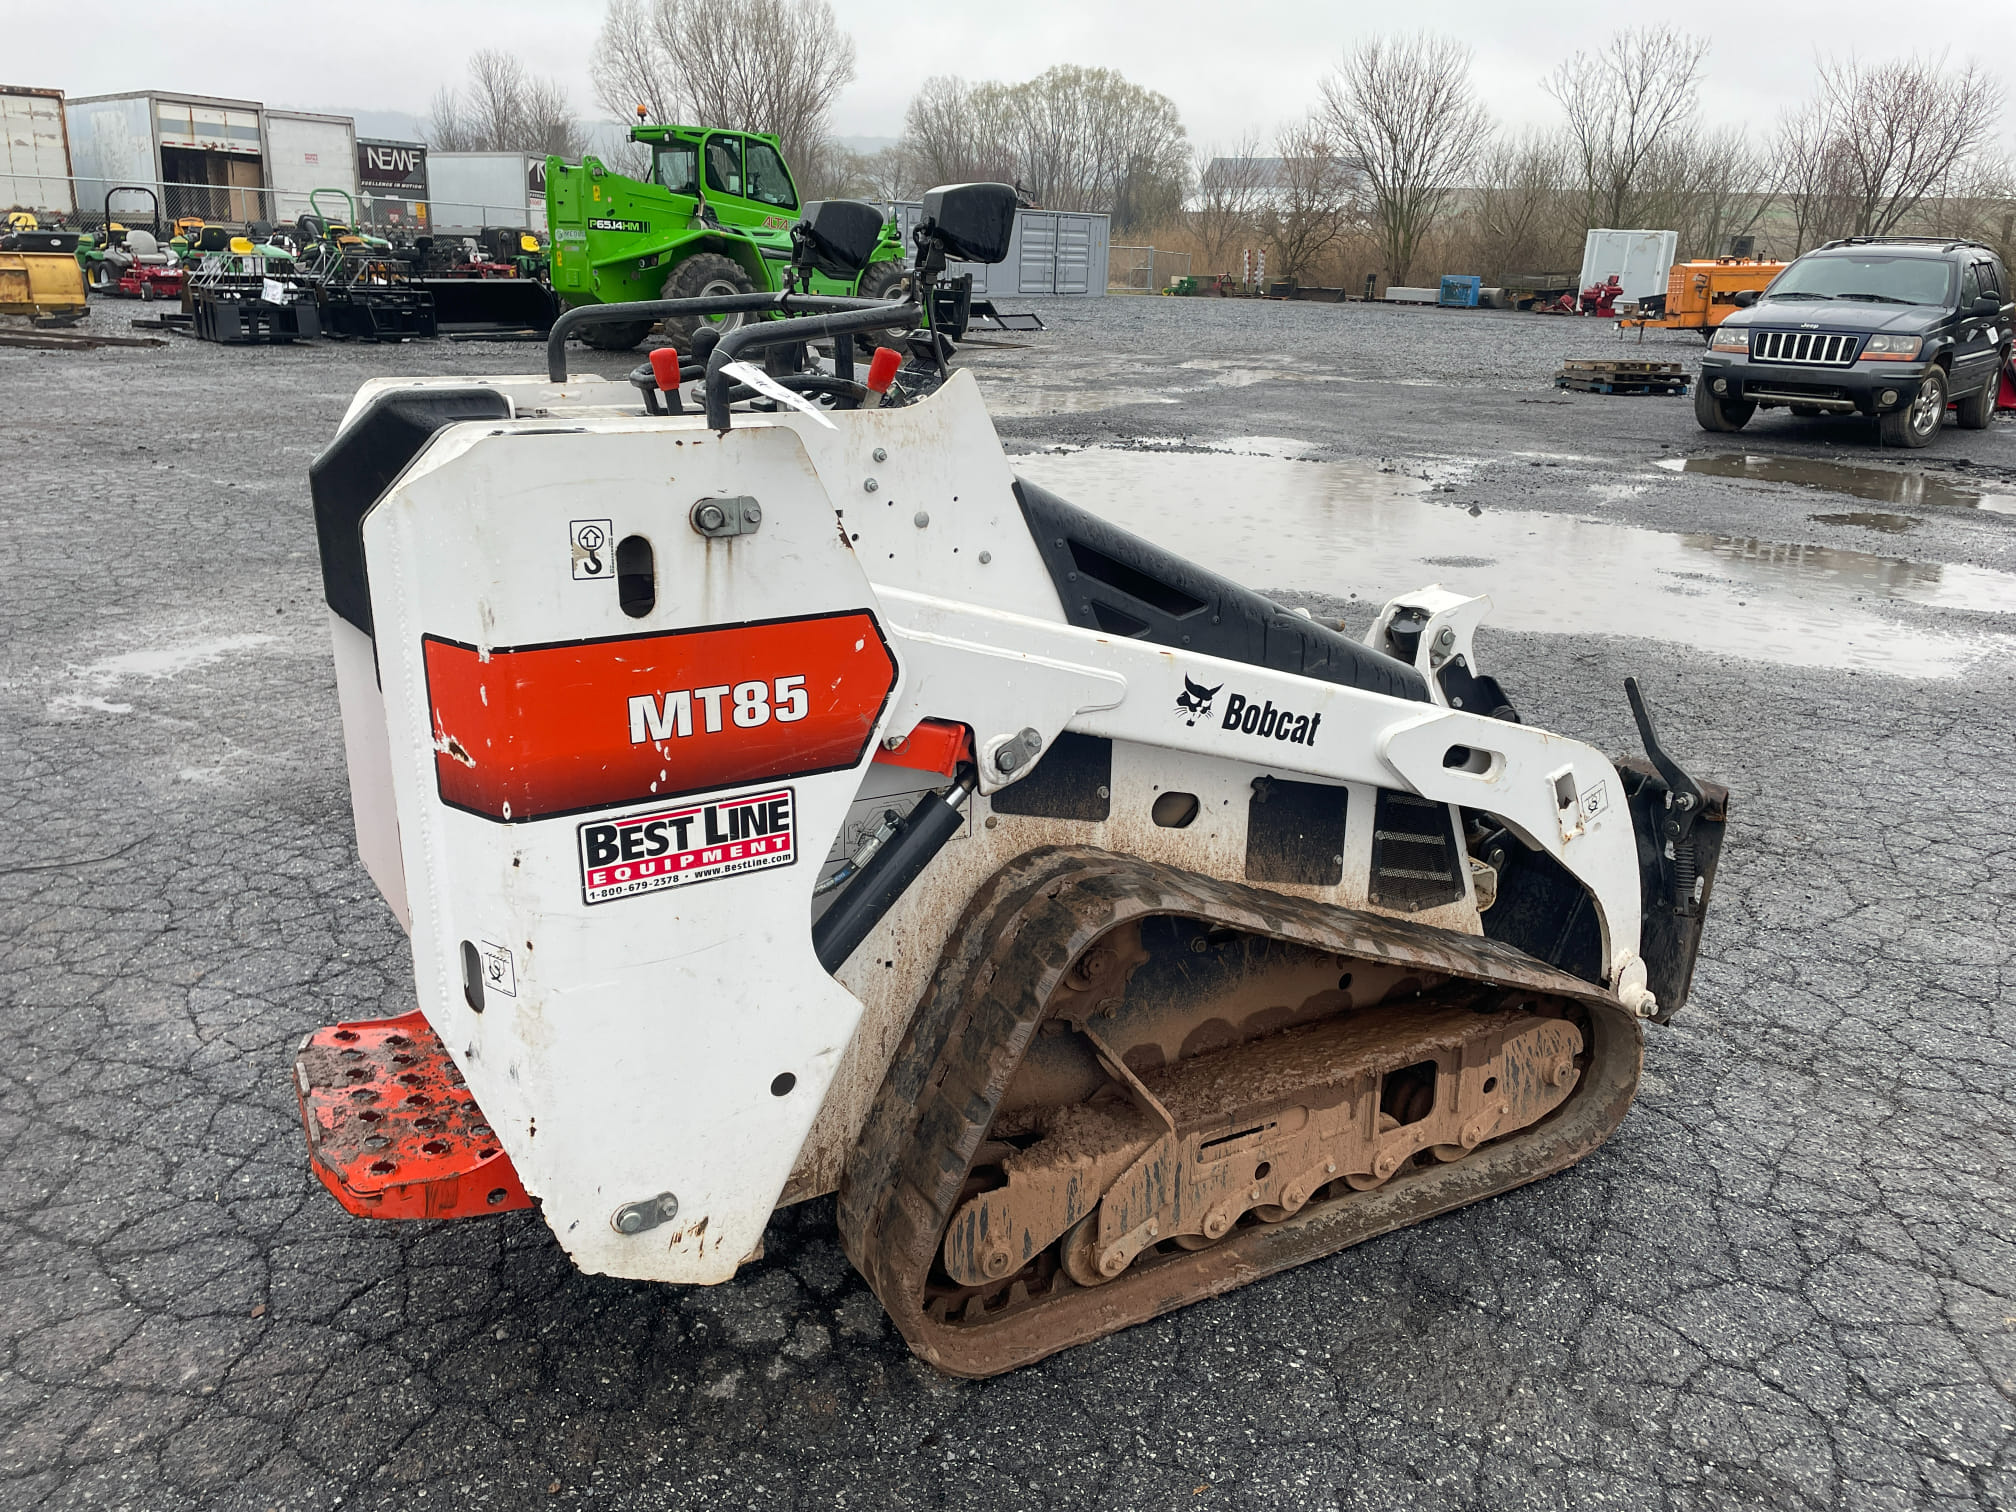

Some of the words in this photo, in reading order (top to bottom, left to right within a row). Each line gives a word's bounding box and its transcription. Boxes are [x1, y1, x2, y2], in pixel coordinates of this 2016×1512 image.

[367, 146, 420, 172] NEMF
[761, 215, 788, 231] ALTA
[1800, 322, 1819, 330] Jeep
[627, 674, 809, 744] MT85
[1221, 693, 1322, 747] Bobcat
[585, 815, 694, 868] BEST
[704, 798, 790, 846] LINE
[589, 874, 680, 900] 1-800-679-2378
[694, 852, 792, 879] www.BestLine.com
[592, 836, 786, 886] EQUIPMENT
